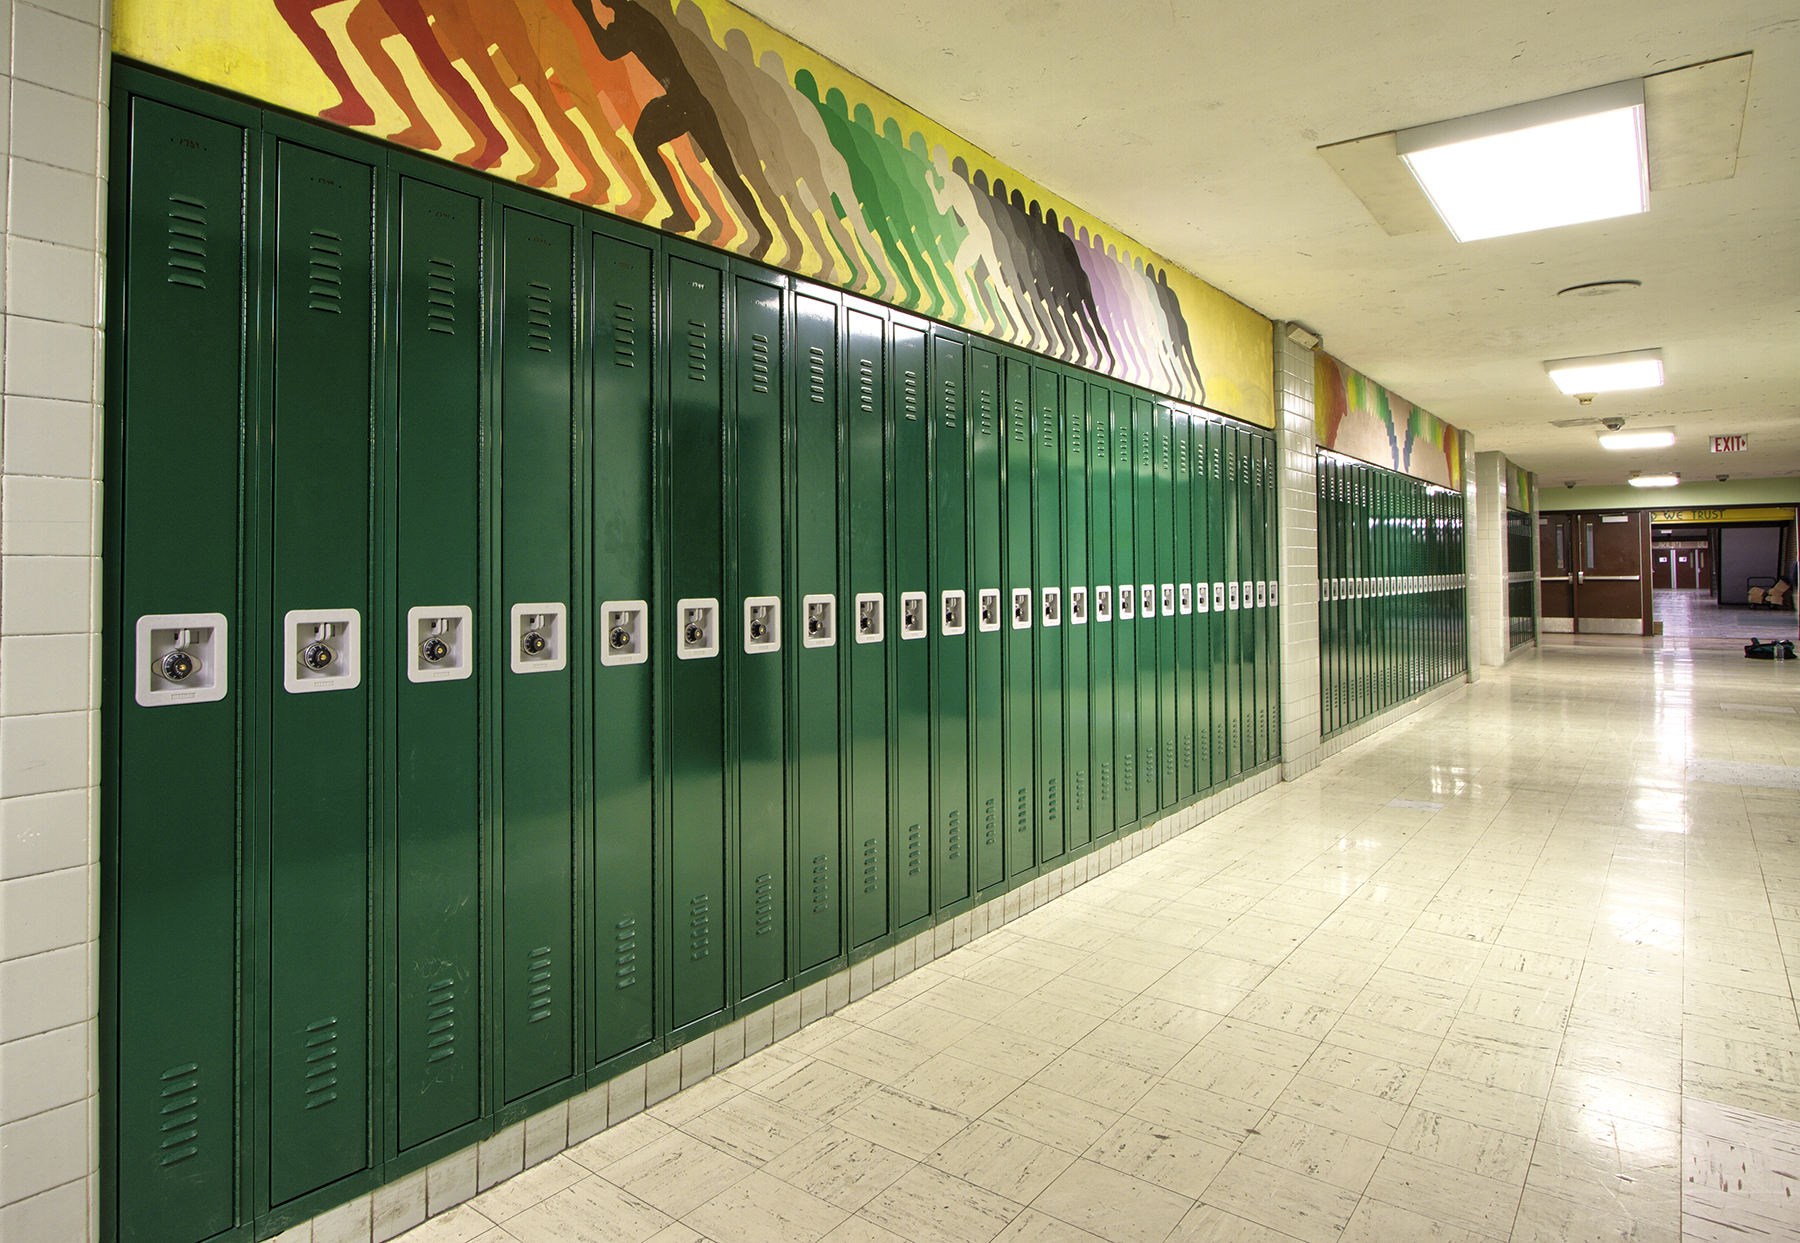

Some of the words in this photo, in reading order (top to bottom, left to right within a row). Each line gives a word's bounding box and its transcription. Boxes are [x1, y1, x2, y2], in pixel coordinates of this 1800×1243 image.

[179, 138, 200, 149] 1739
[1715, 436, 1742, 452] EXIT
[1663, 510, 1683, 520] WE
[1691, 509, 1726, 520] TRUST
